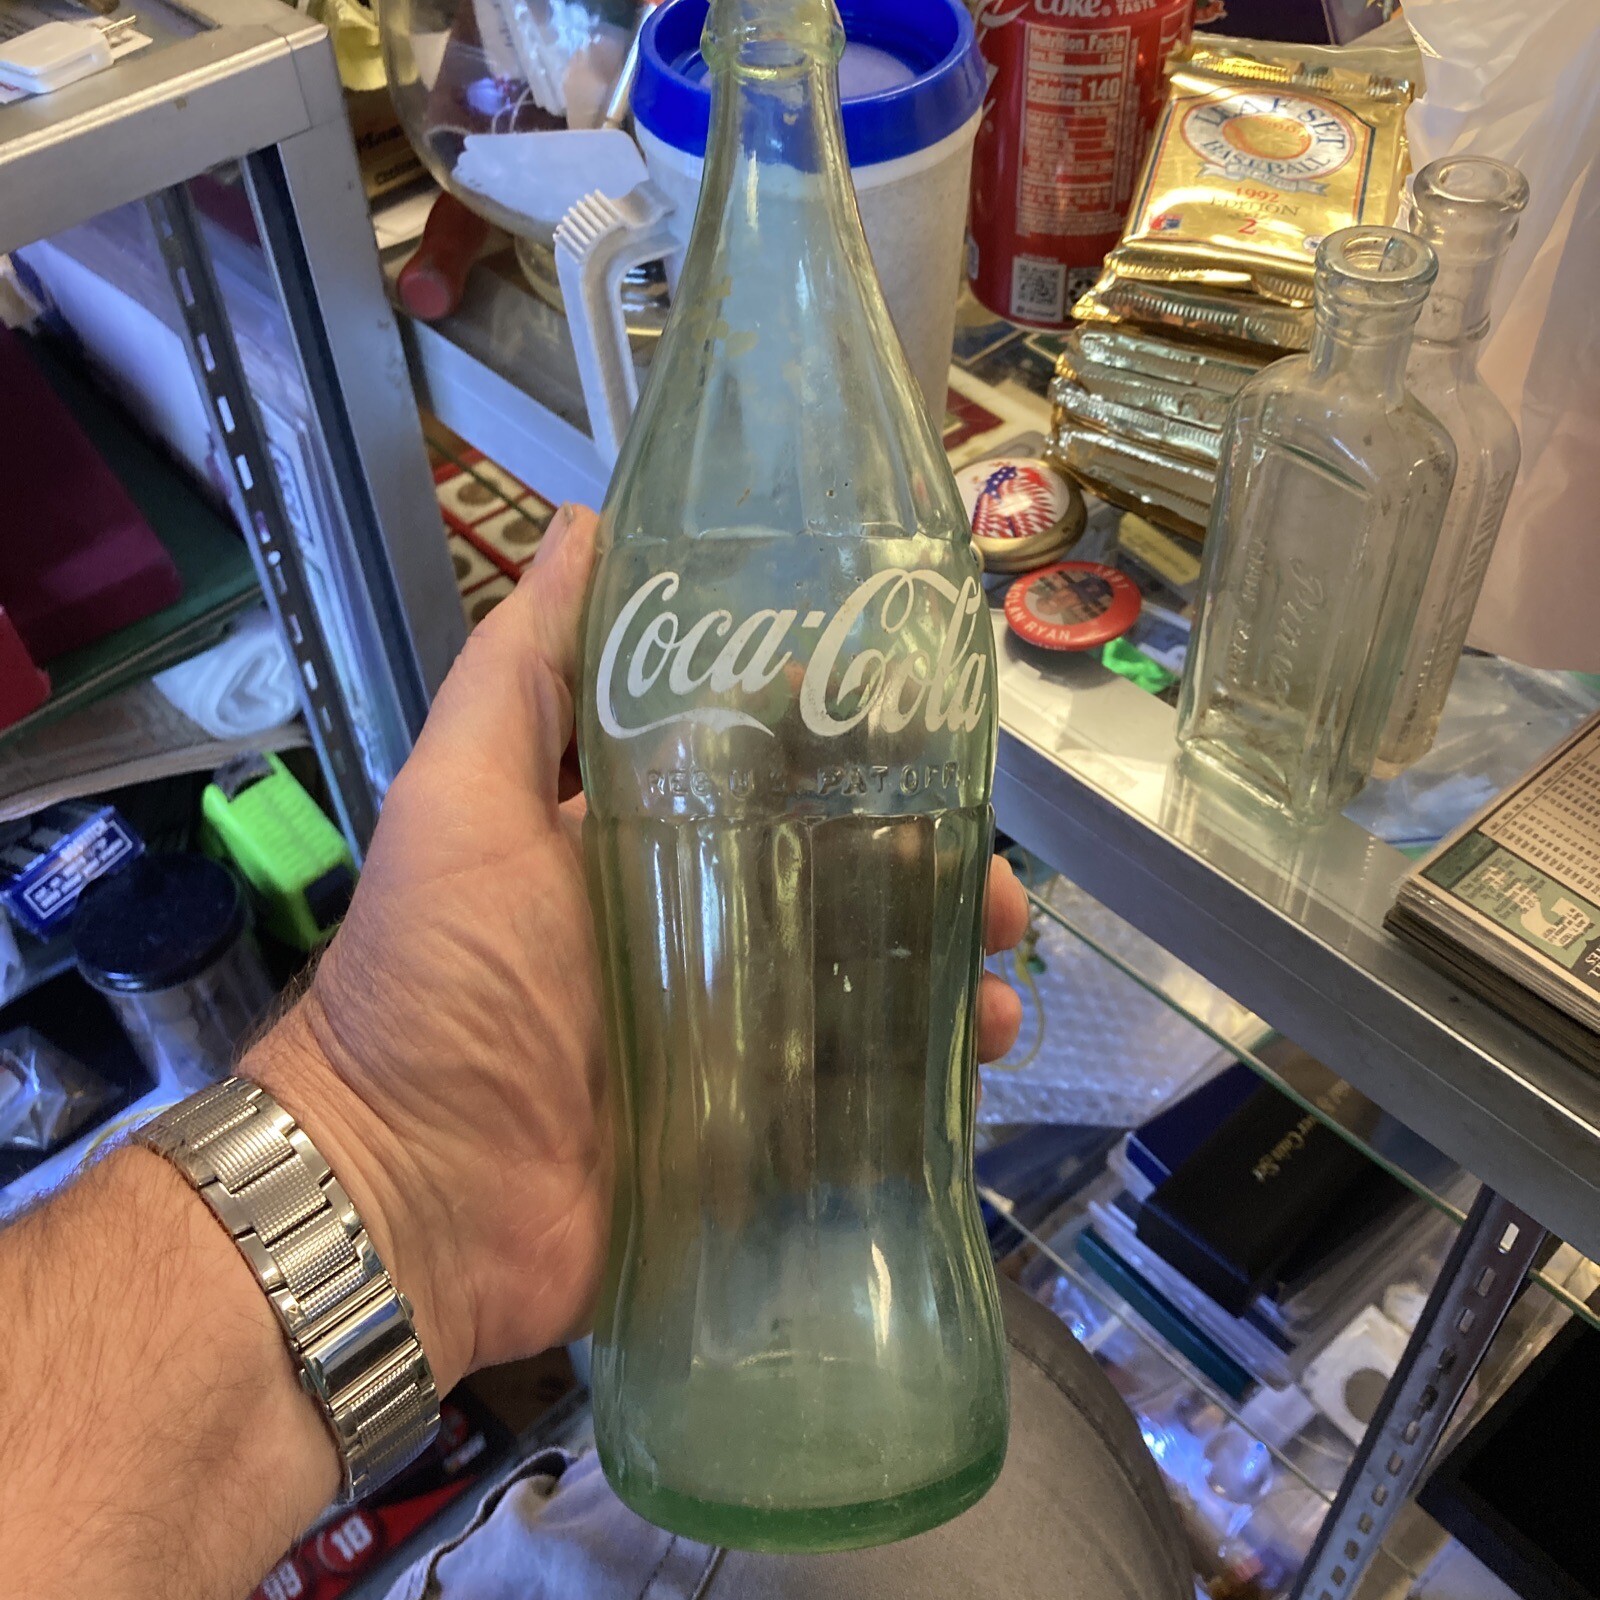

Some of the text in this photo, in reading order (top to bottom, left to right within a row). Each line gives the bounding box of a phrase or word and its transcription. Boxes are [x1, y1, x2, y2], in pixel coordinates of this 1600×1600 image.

[1029, 30, 1125, 51] Nutrition Facts
[1027, 78, 1120, 101] Calories 140
[1298, 107, 1347, 150] SET
[1202, 139, 1332, 175] BASEBALL
[1209, 195, 1302, 217] EDITION
[1236, 186, 1280, 204] 1992
[1238, 217, 1258, 236] 2
[1005, 582, 1071, 641] NOLAN RYAN
[596, 567, 987, 740] Coca-Cola
